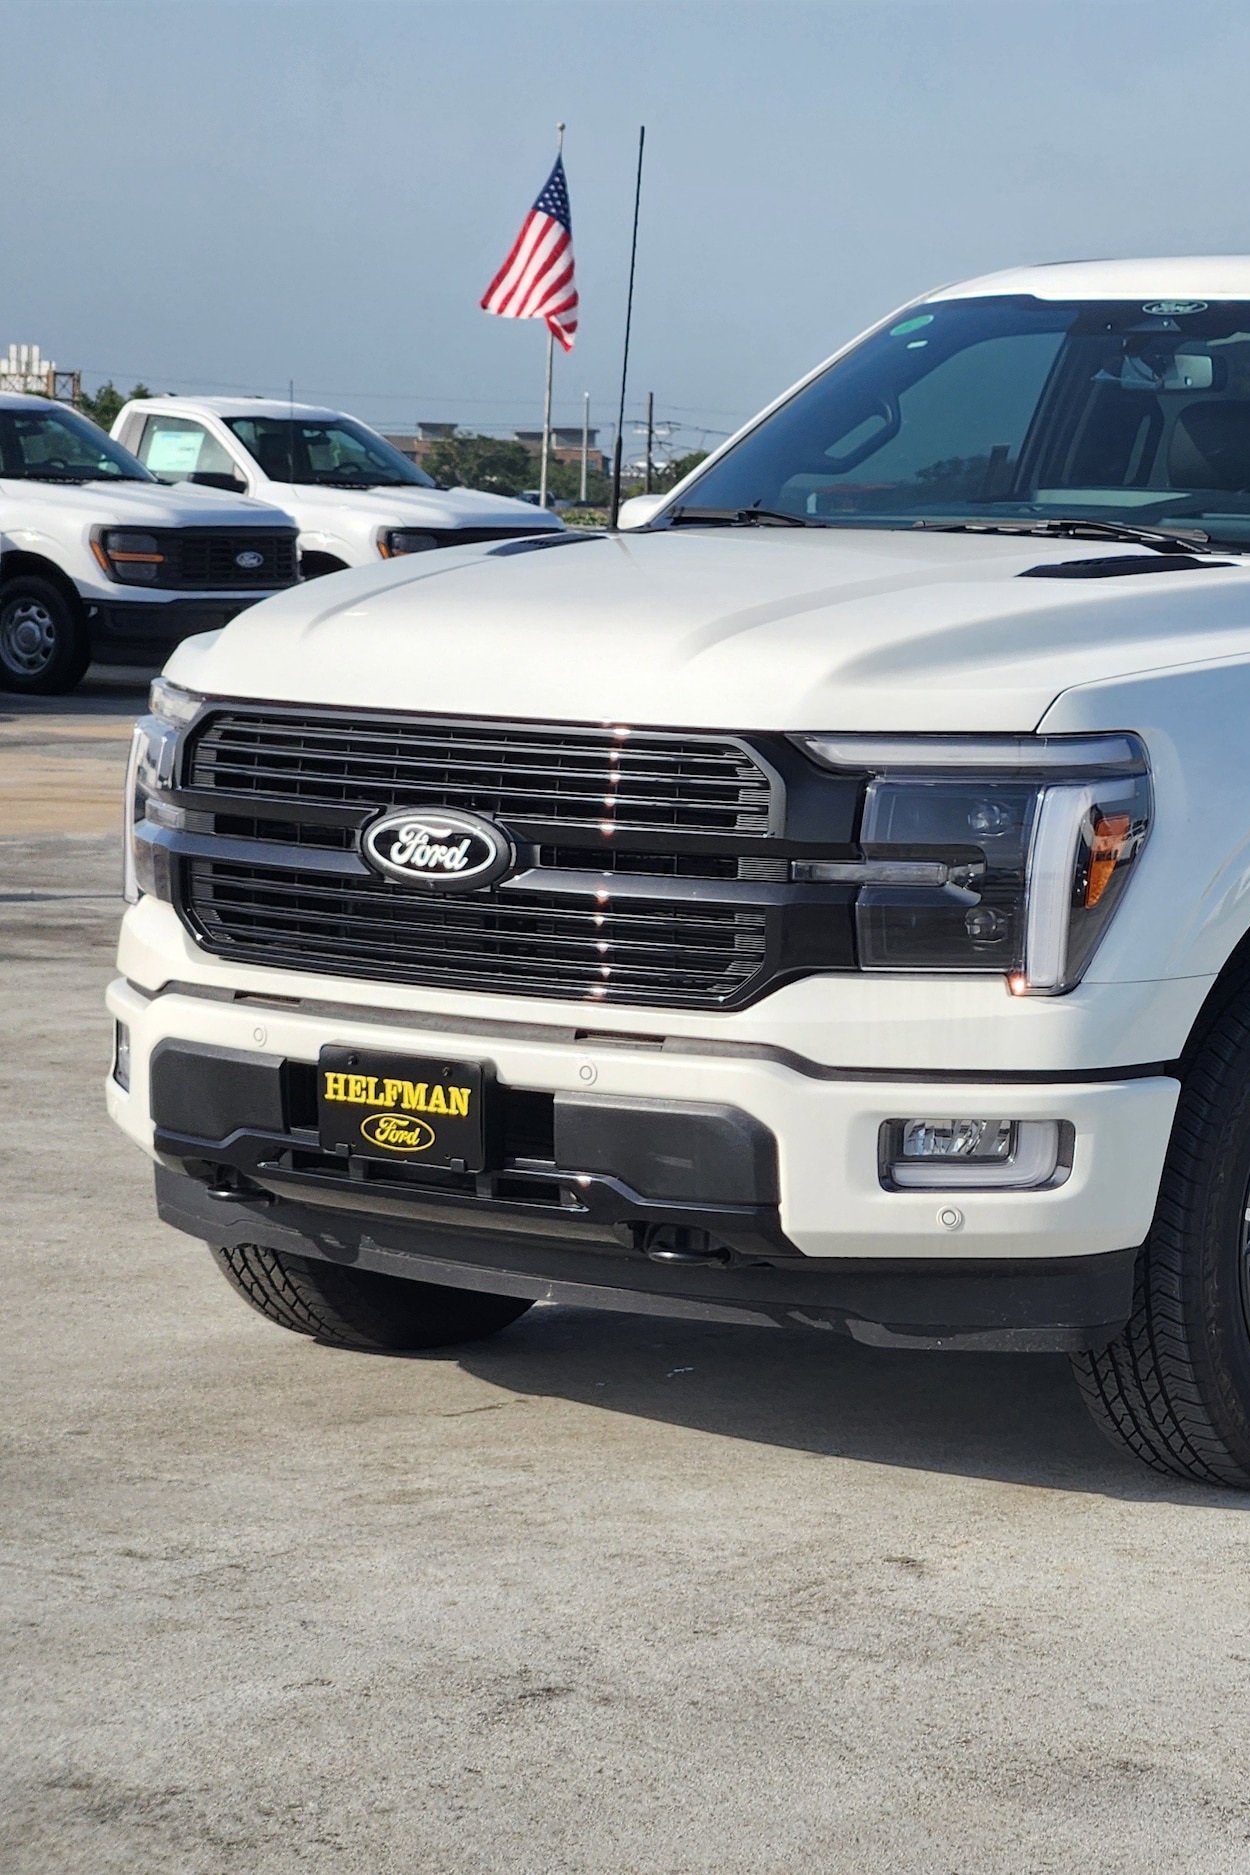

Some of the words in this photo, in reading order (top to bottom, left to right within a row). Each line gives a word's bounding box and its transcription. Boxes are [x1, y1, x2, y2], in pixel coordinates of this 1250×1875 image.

[390, 823, 472, 871] Ford
[324, 1072, 471, 1116] HELFMAN
[375, 1117, 421, 1146] Ford
